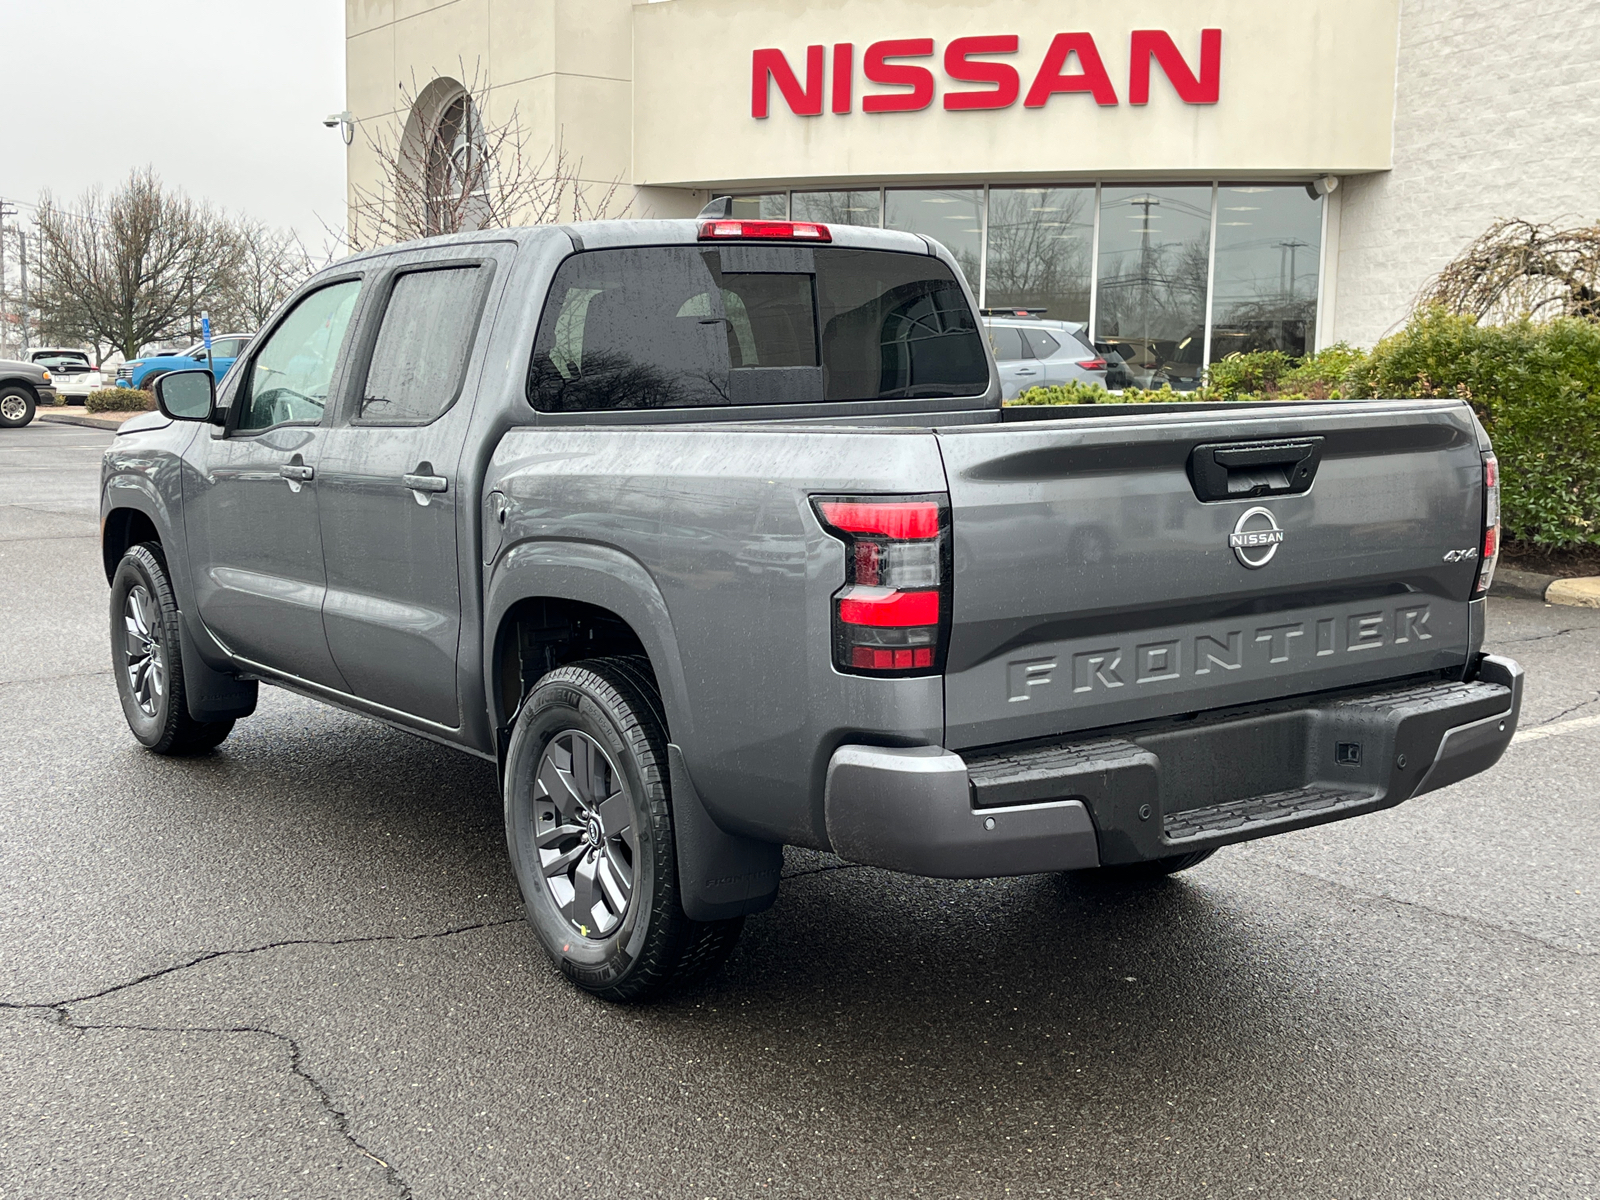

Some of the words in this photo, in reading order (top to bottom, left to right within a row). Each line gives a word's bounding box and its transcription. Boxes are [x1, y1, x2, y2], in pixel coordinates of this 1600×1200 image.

[751, 28, 1222, 118] NISSAN
[1232, 531, 1284, 545] NISSAN
[1006, 604, 1432, 702] FRONTIER
